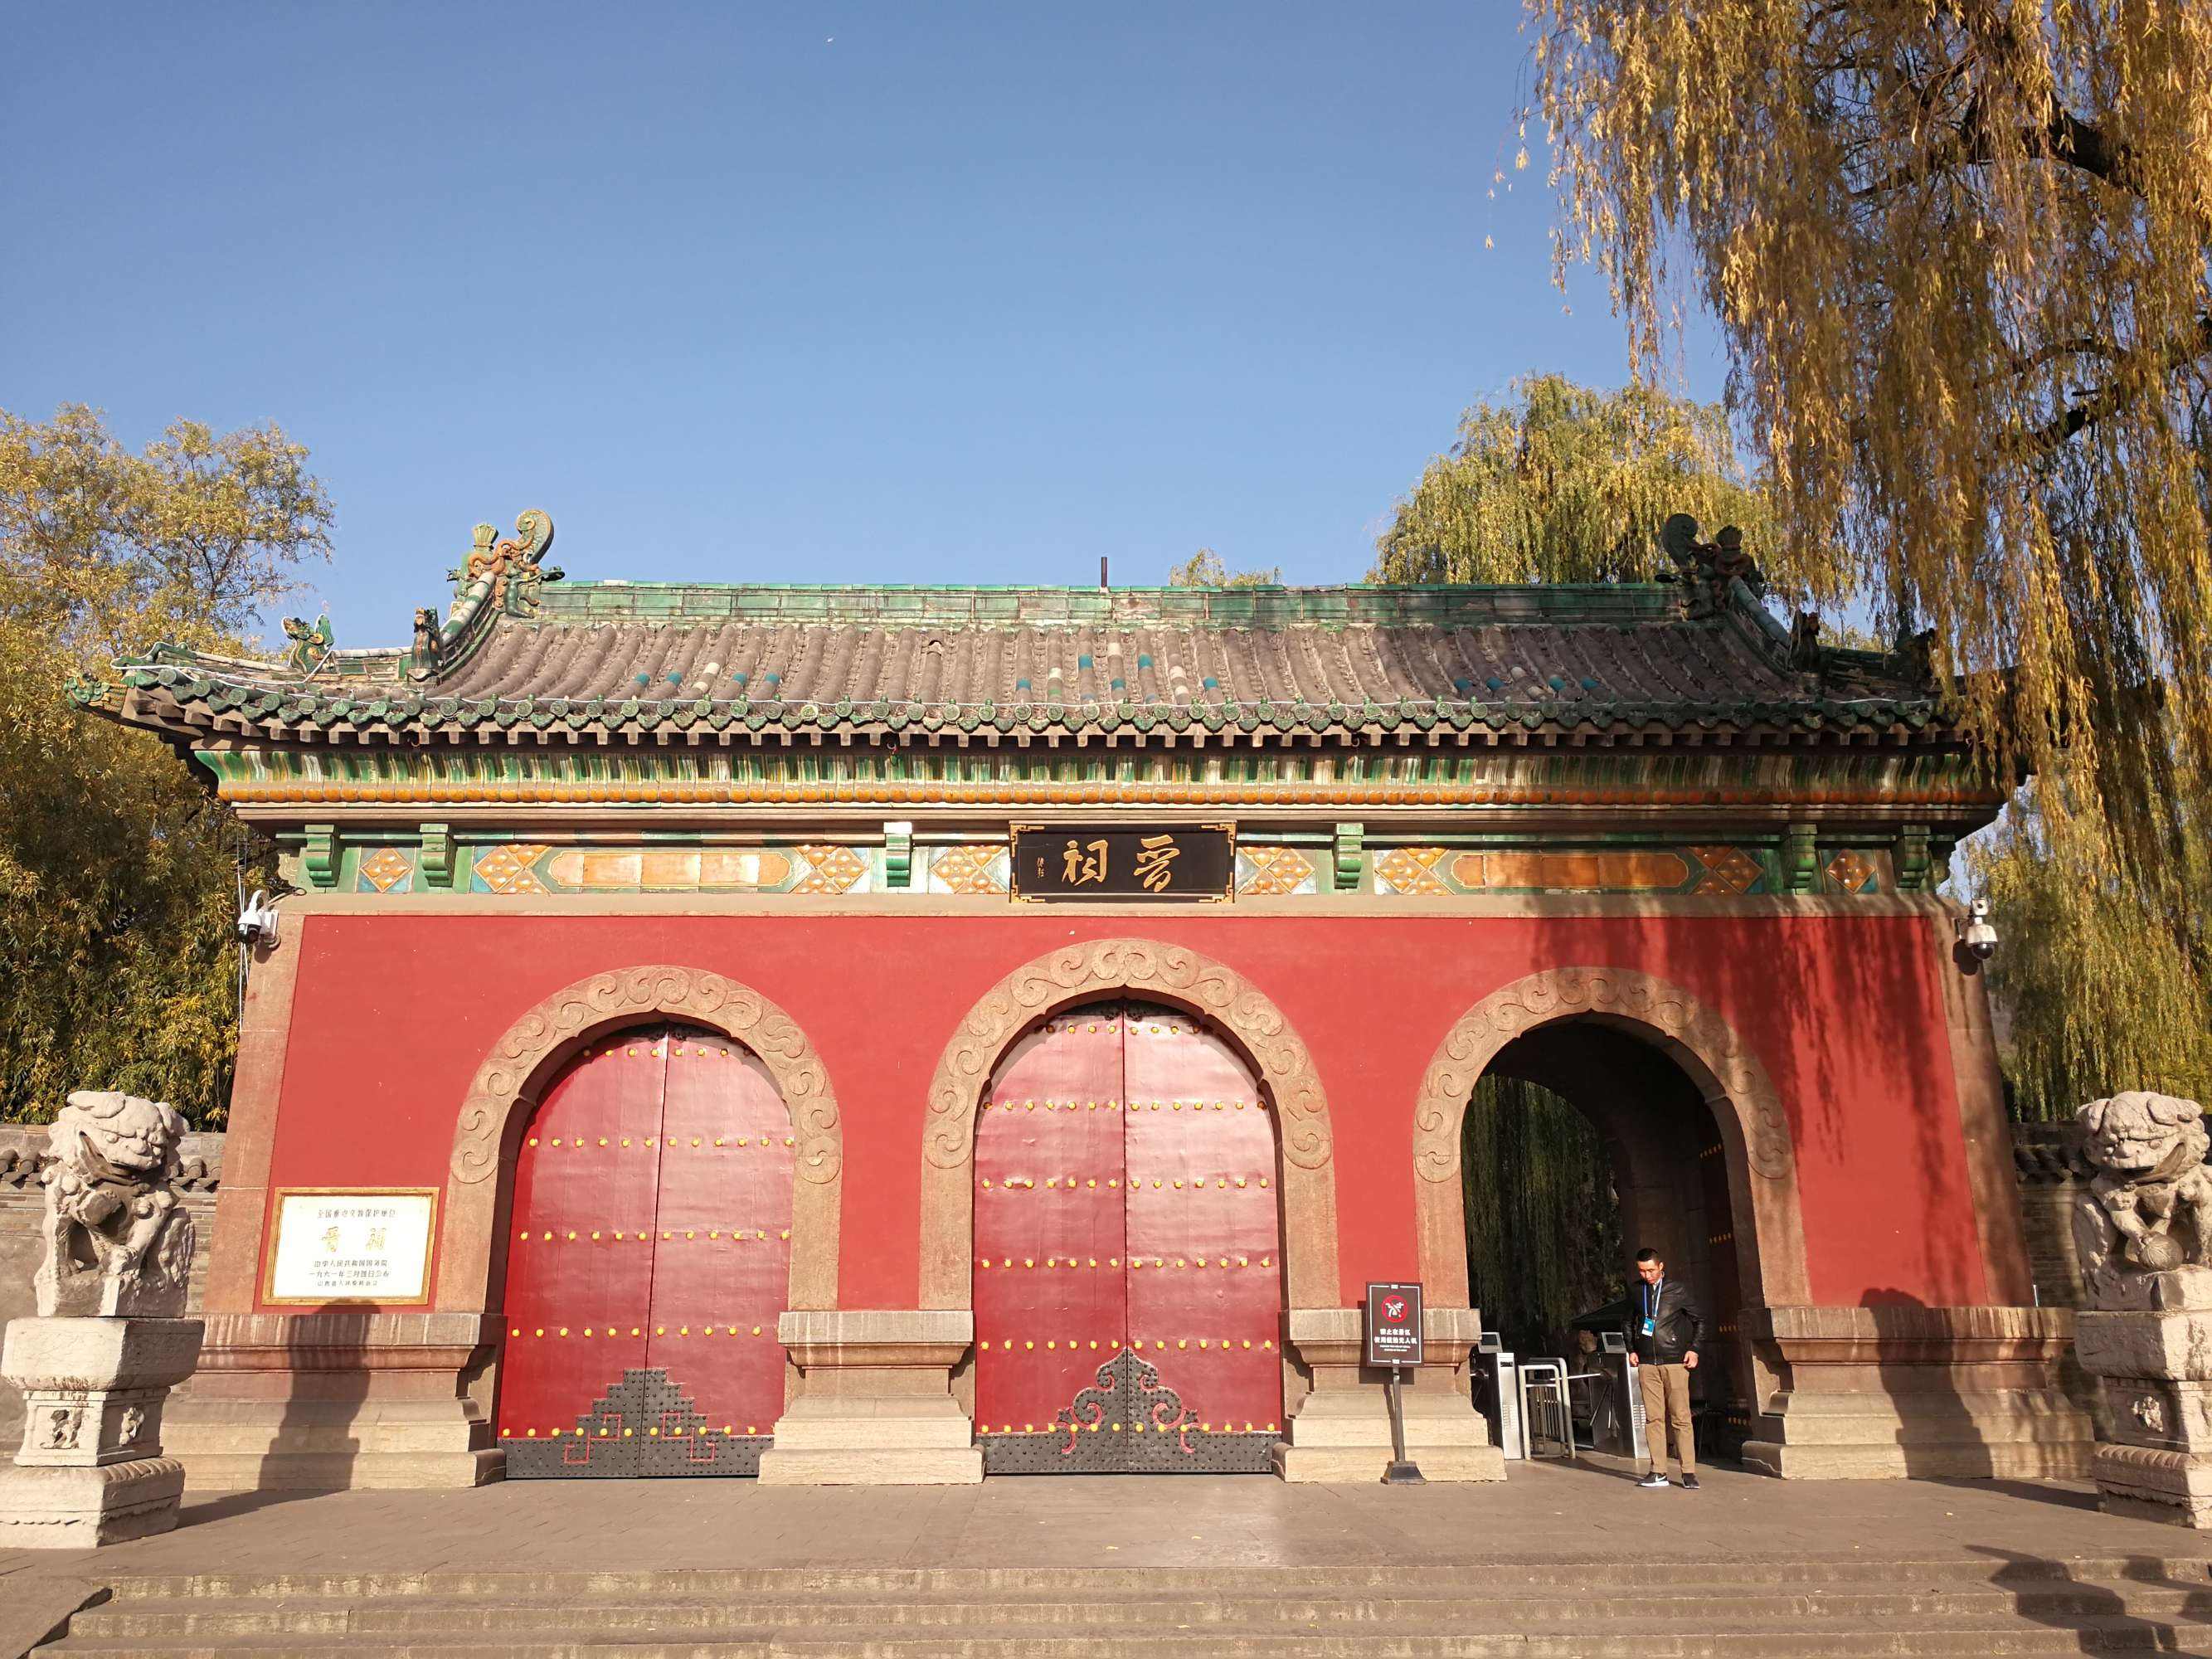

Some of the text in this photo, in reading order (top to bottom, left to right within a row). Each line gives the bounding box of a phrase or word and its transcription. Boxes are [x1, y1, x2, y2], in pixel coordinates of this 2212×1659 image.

[1062, 834, 1180, 893] 晋祠
[318, 1208, 396, 1219] 全国重点文物保护单位
[321, 1226, 386, 1253] 晋祠
